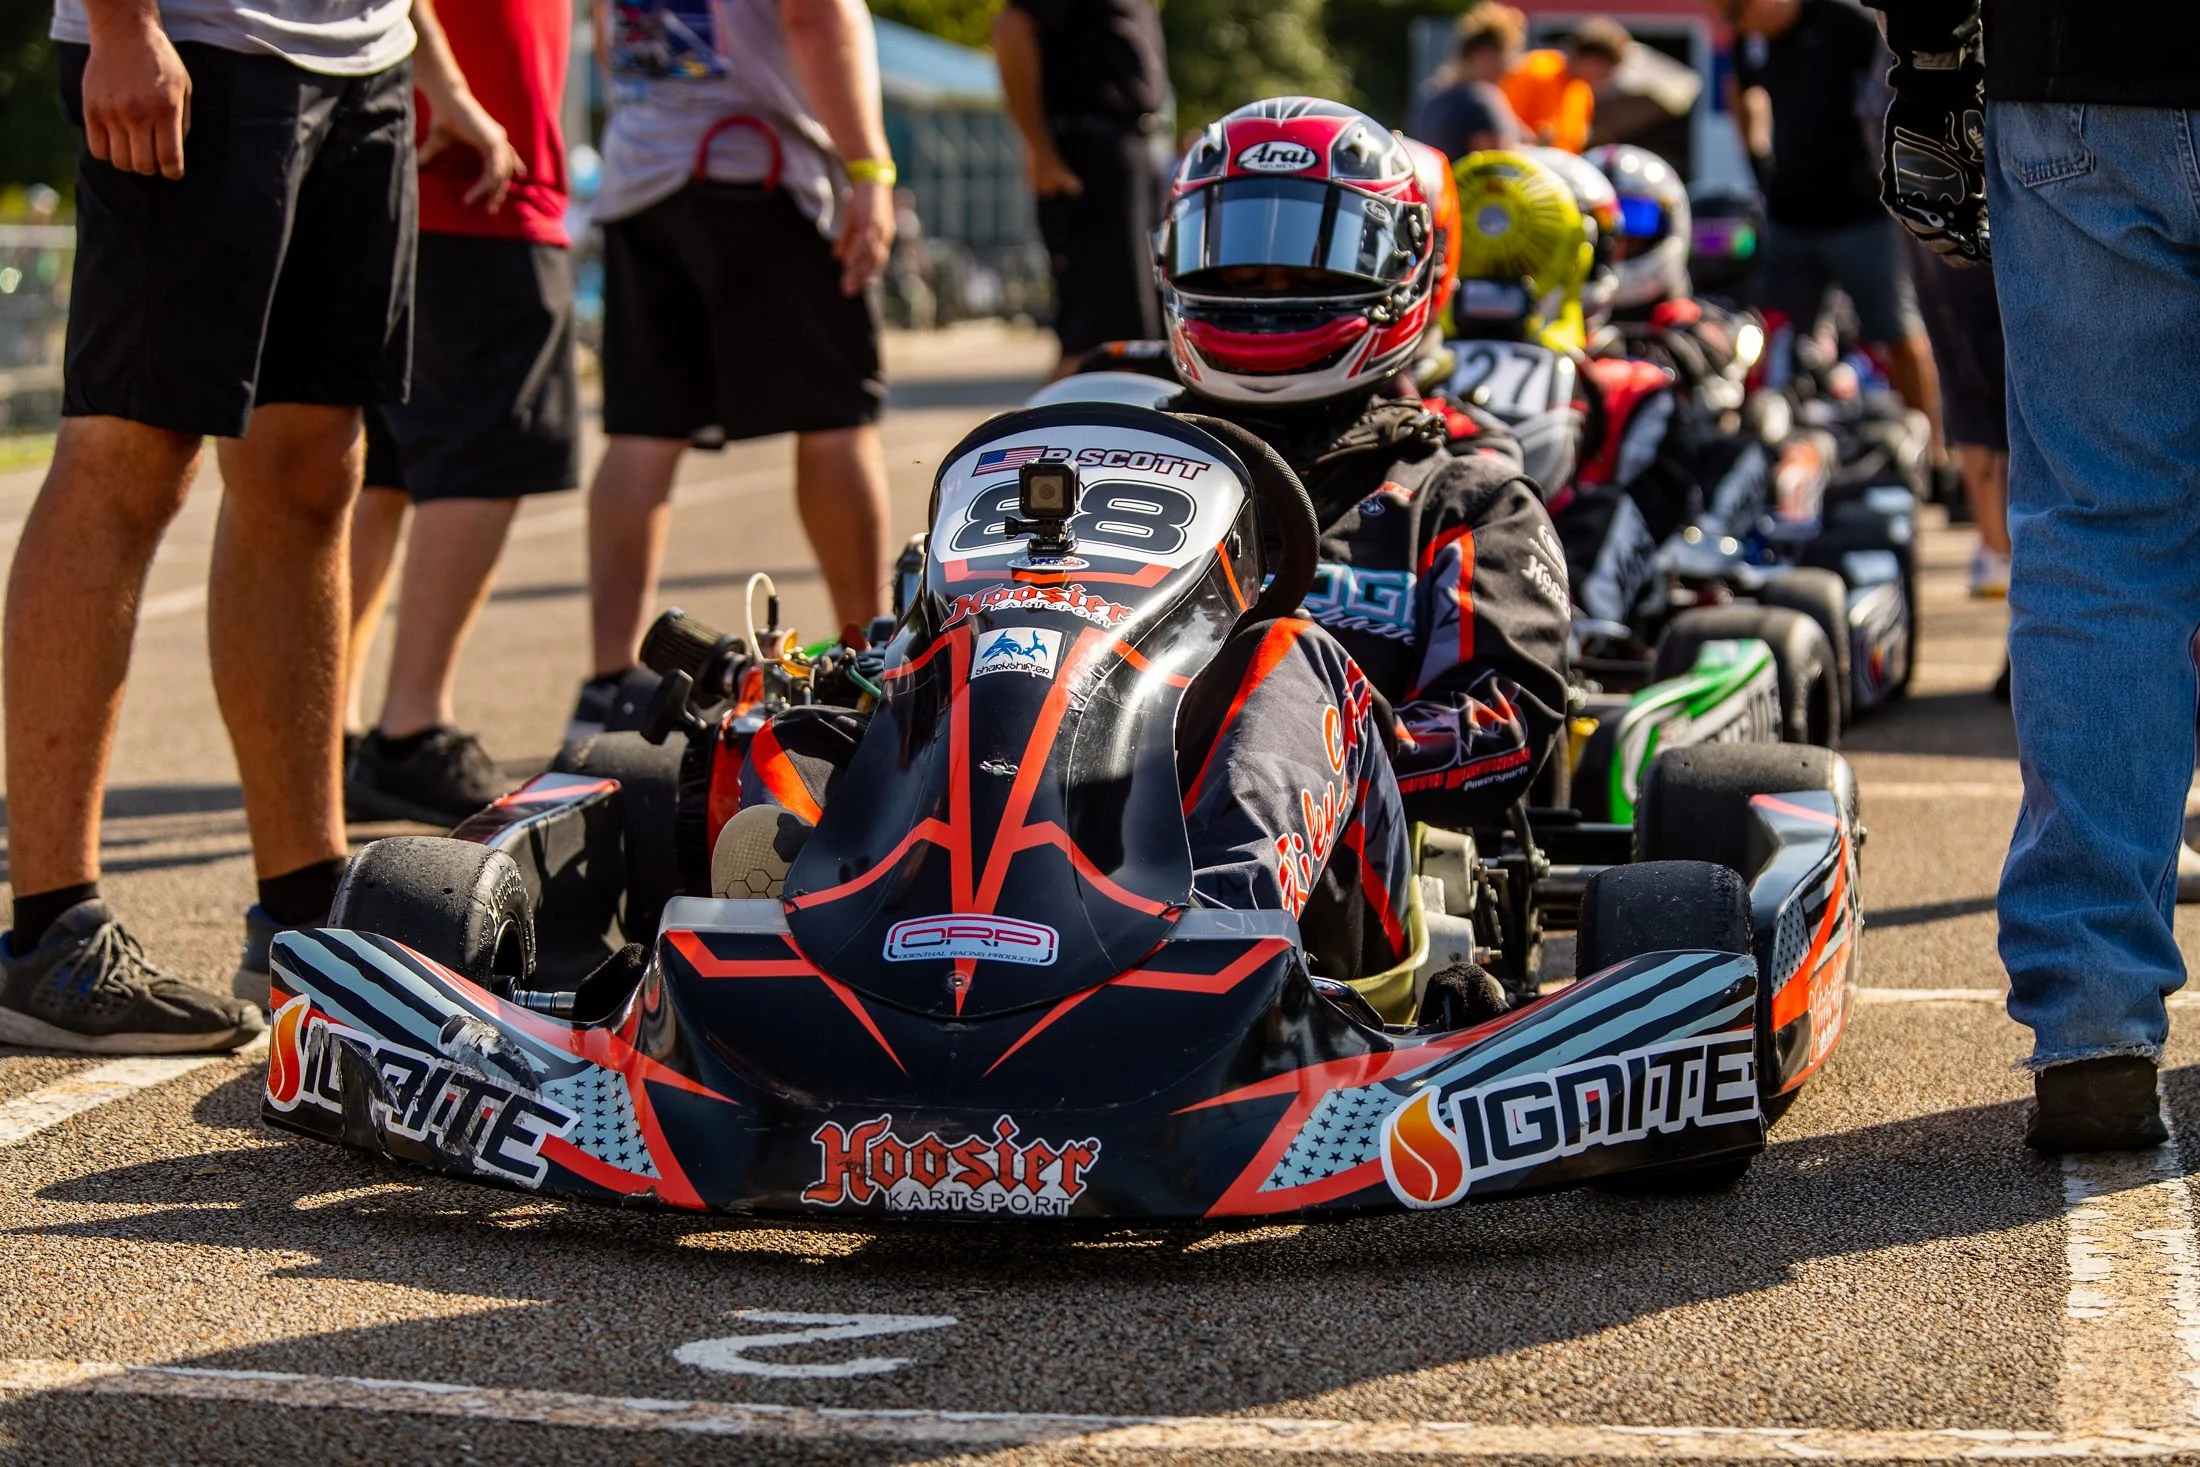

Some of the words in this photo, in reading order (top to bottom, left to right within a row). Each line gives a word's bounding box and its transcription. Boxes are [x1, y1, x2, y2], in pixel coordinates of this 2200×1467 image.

[1241, 143, 1310, 163] Arai
[1456, 347, 1541, 404] 27
[1077, 448, 1211, 480] SCOTT
[940, 584, 1137, 632] Hoosier
[988, 953, 1040, 963] PRODUCTS
[1452, 1032, 1757, 1178] IGNITE
[801, 1113, 1101, 1206] Hoosier
[886, 1190, 1071, 1216] KARTSPORT
